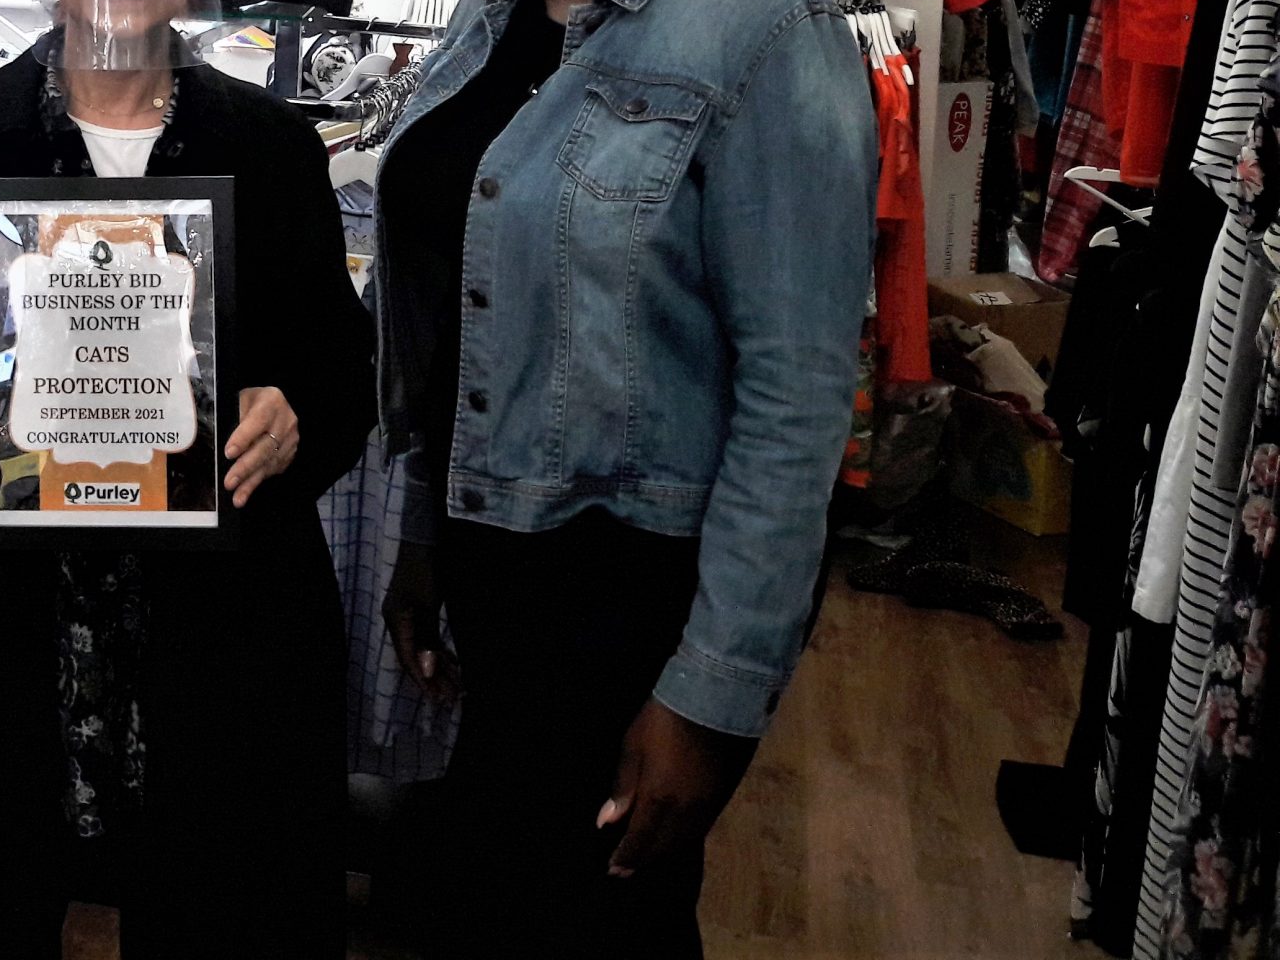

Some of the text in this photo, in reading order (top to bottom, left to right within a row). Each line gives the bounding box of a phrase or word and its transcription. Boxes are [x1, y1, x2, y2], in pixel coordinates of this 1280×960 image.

[952, 100, 968, 145] PEAK
[48, 273, 162, 288] PURLEY BID
[22, 295, 191, 310] BUSINESS OF THE
[69, 316, 141, 331] MONTH
[74, 346, 130, 363] CATS
[33, 377, 172, 394] PROTECTION
[40, 408, 166, 420] SEPTEMBER 2021
[26, 431, 180, 444] CONGRATULATIONS!
[84, 484, 141, 503] Purley
